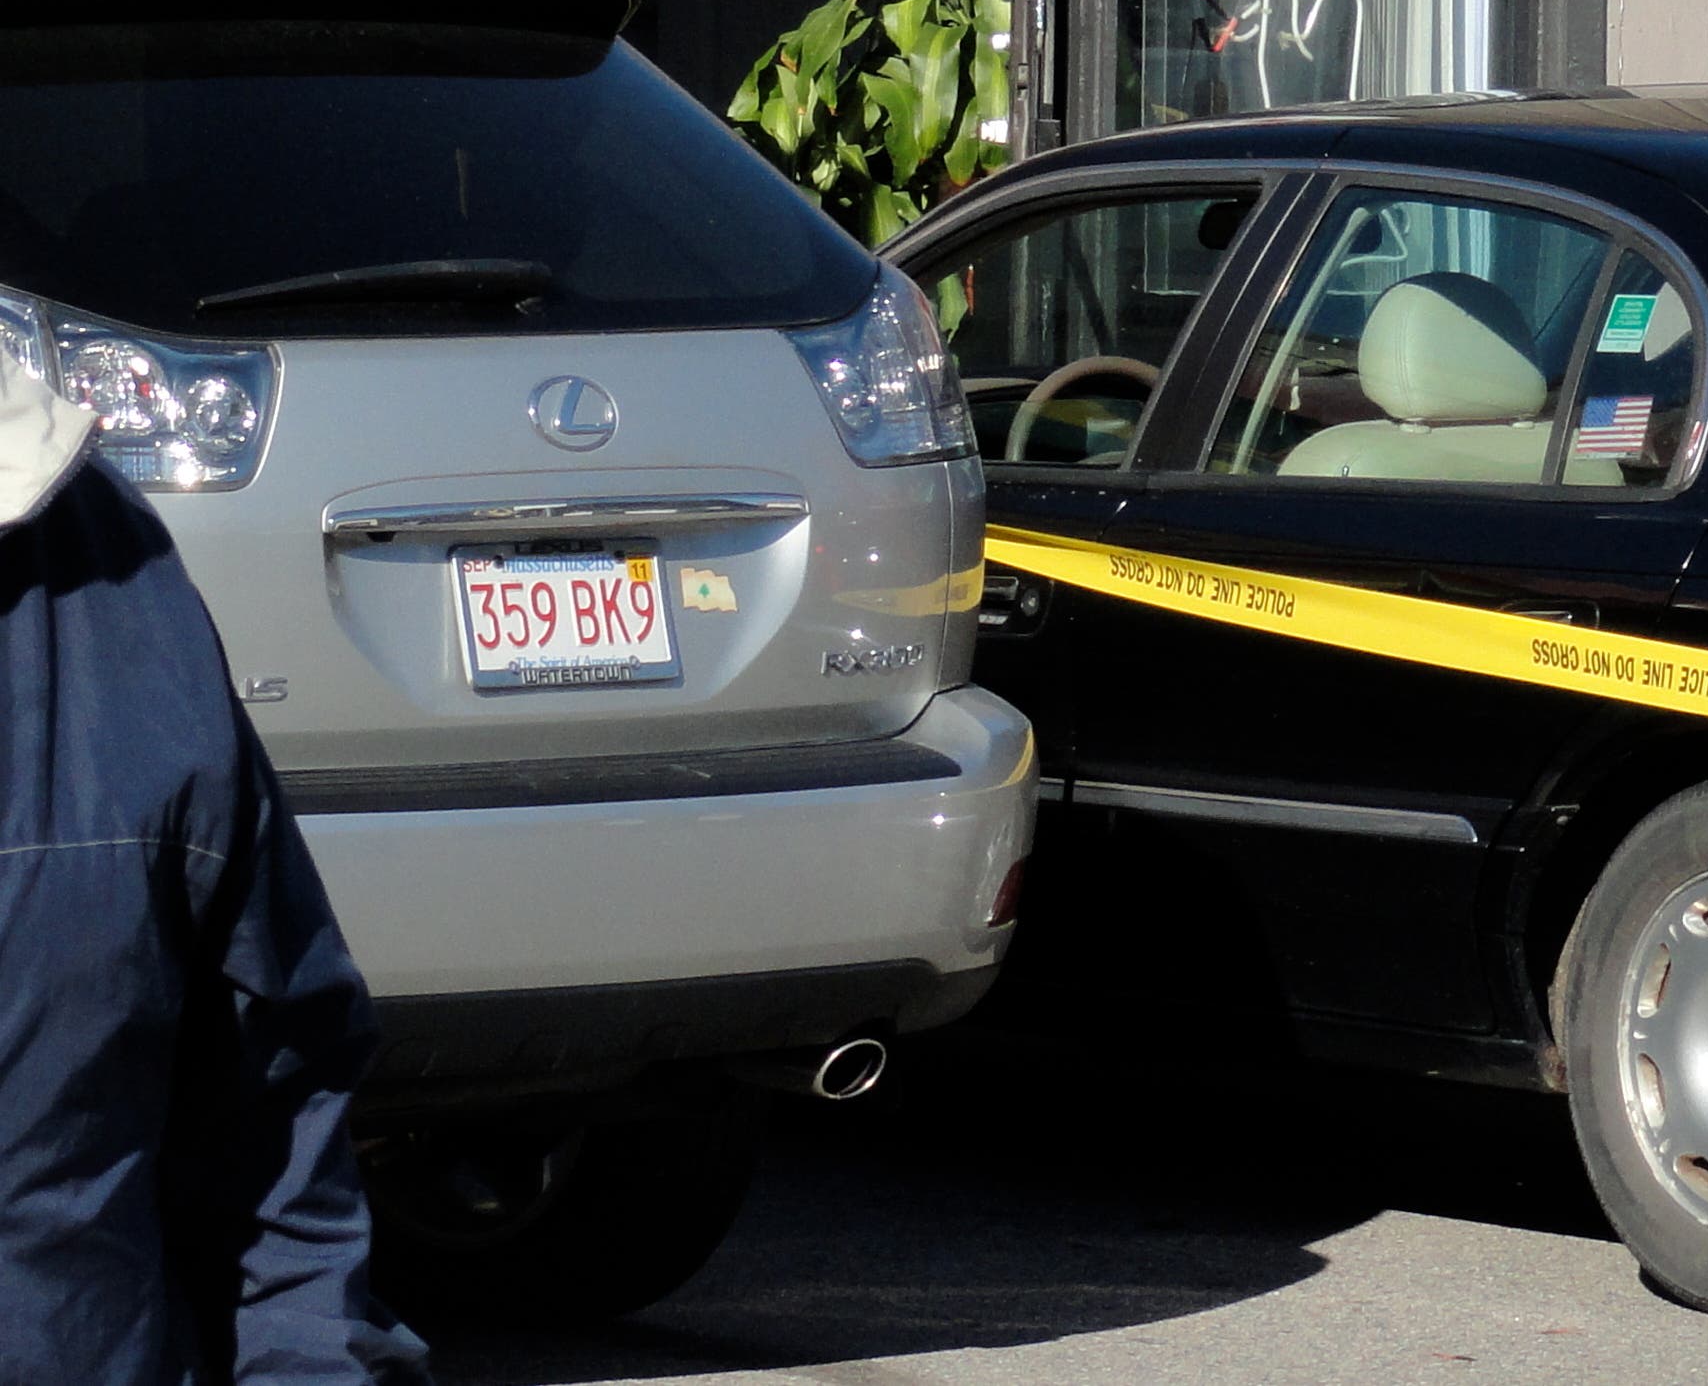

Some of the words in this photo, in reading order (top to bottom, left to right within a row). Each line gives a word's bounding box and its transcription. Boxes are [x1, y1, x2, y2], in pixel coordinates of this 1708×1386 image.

[631, 562, 648, 580] 11
[1110, 554, 1154, 584] CROSS
[1156, 565, 1184, 592] NOT
[1187, 571, 1206, 597] DO
[1210, 576, 1241, 606] LINE
[1245, 584, 1296, 618] POLICE
[470, 581, 557, 650] 359
[570, 578, 656, 647] BK9
[1532, 638, 1579, 671] CROSS
[1583, 648, 1611, 678] NOT
[1615, 655, 1635, 682] DO
[1642, 659, 1674, 689] LINE
